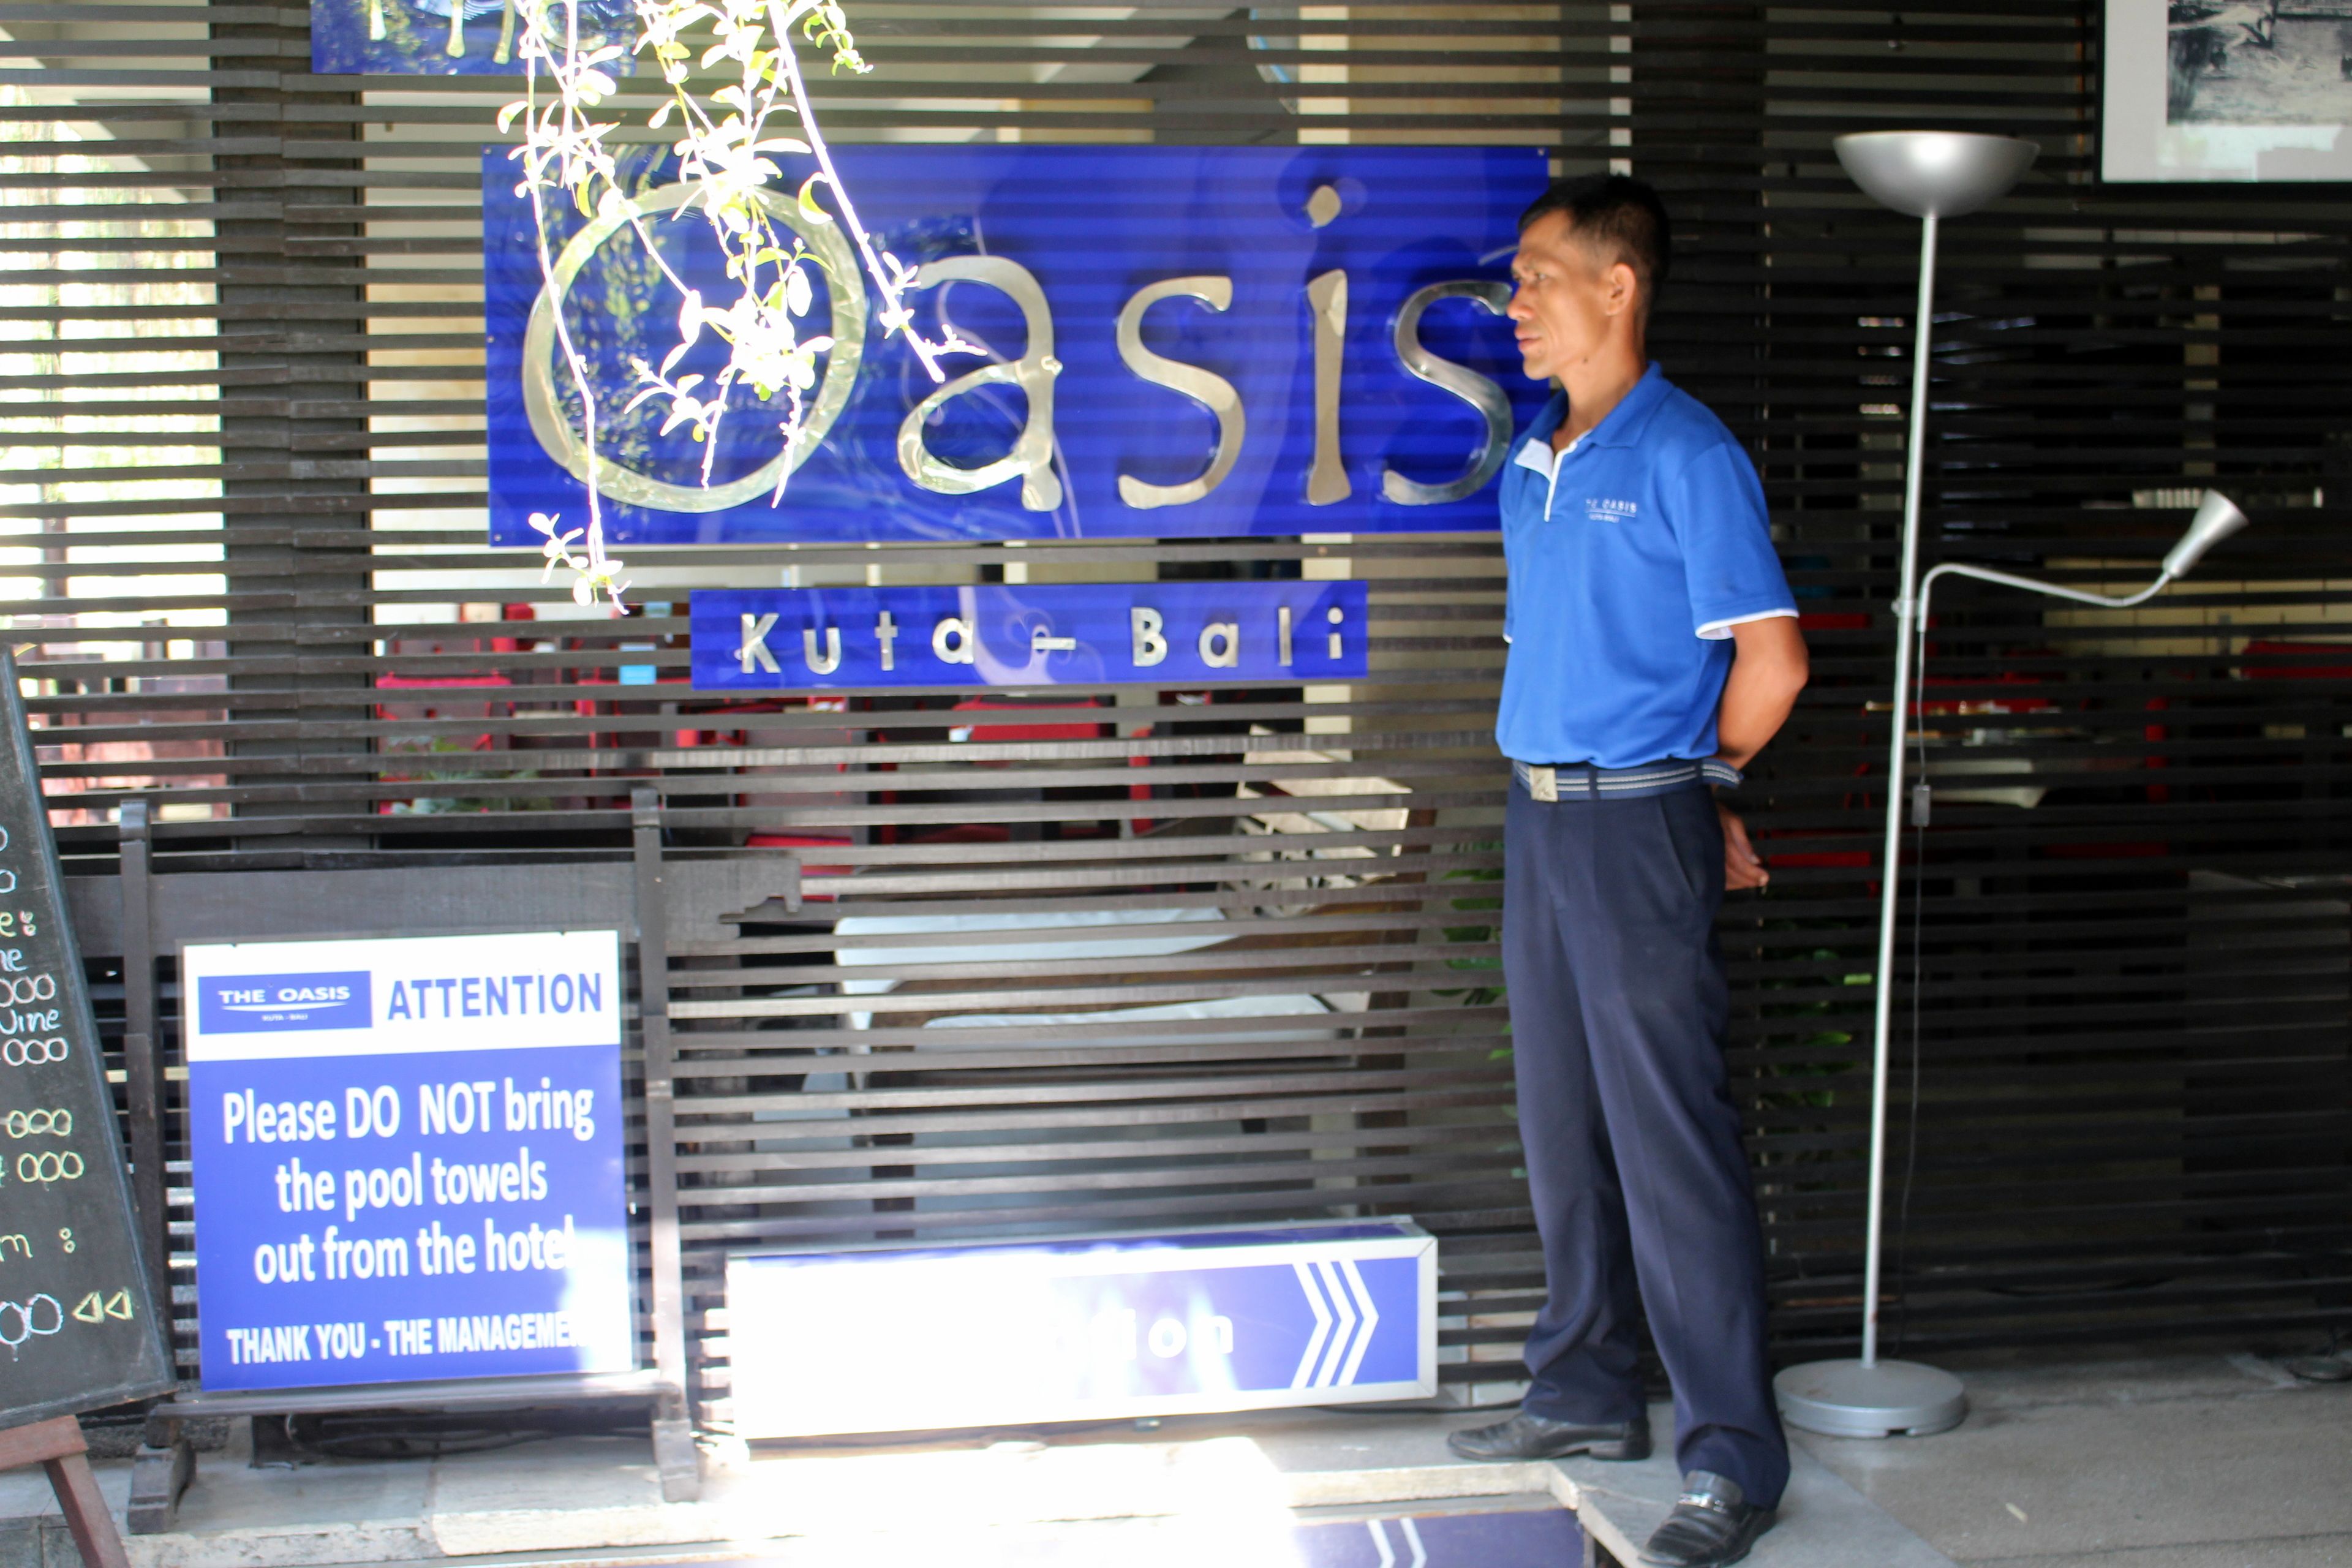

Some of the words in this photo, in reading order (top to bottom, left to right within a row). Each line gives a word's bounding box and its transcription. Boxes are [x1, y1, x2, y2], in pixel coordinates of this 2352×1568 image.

[521, 181, 1514, 514] Oasis
[738, 609, 975, 675] Kuta
[1131, 606, 1343, 668] Bali
[218, 989, 266, 1004] THE
[277, 986, 351, 1003] OASIS
[388, 972, 602, 1021] ATTENTION
[223, 1088, 336, 1144] Please
[346, 1085, 401, 1140] DO
[420, 1082, 496, 1136] NOT
[505, 1077, 595, 1141] bring
[276, 1158, 335, 1213] the
[346, 1152, 423, 1222] pool
[432, 1147, 548, 1205] towels
[254, 1234, 315, 1283] out
[322, 1226, 409, 1280] from
[417, 1221, 477, 1275] the
[485, 1214, 576, 1272] hotel
[226, 1325, 310, 1365] THANK
[315, 1322, 365, 1359] YOU
[384, 1319, 432, 1356] THE
[437, 1311, 590, 1353] MANAGEME
